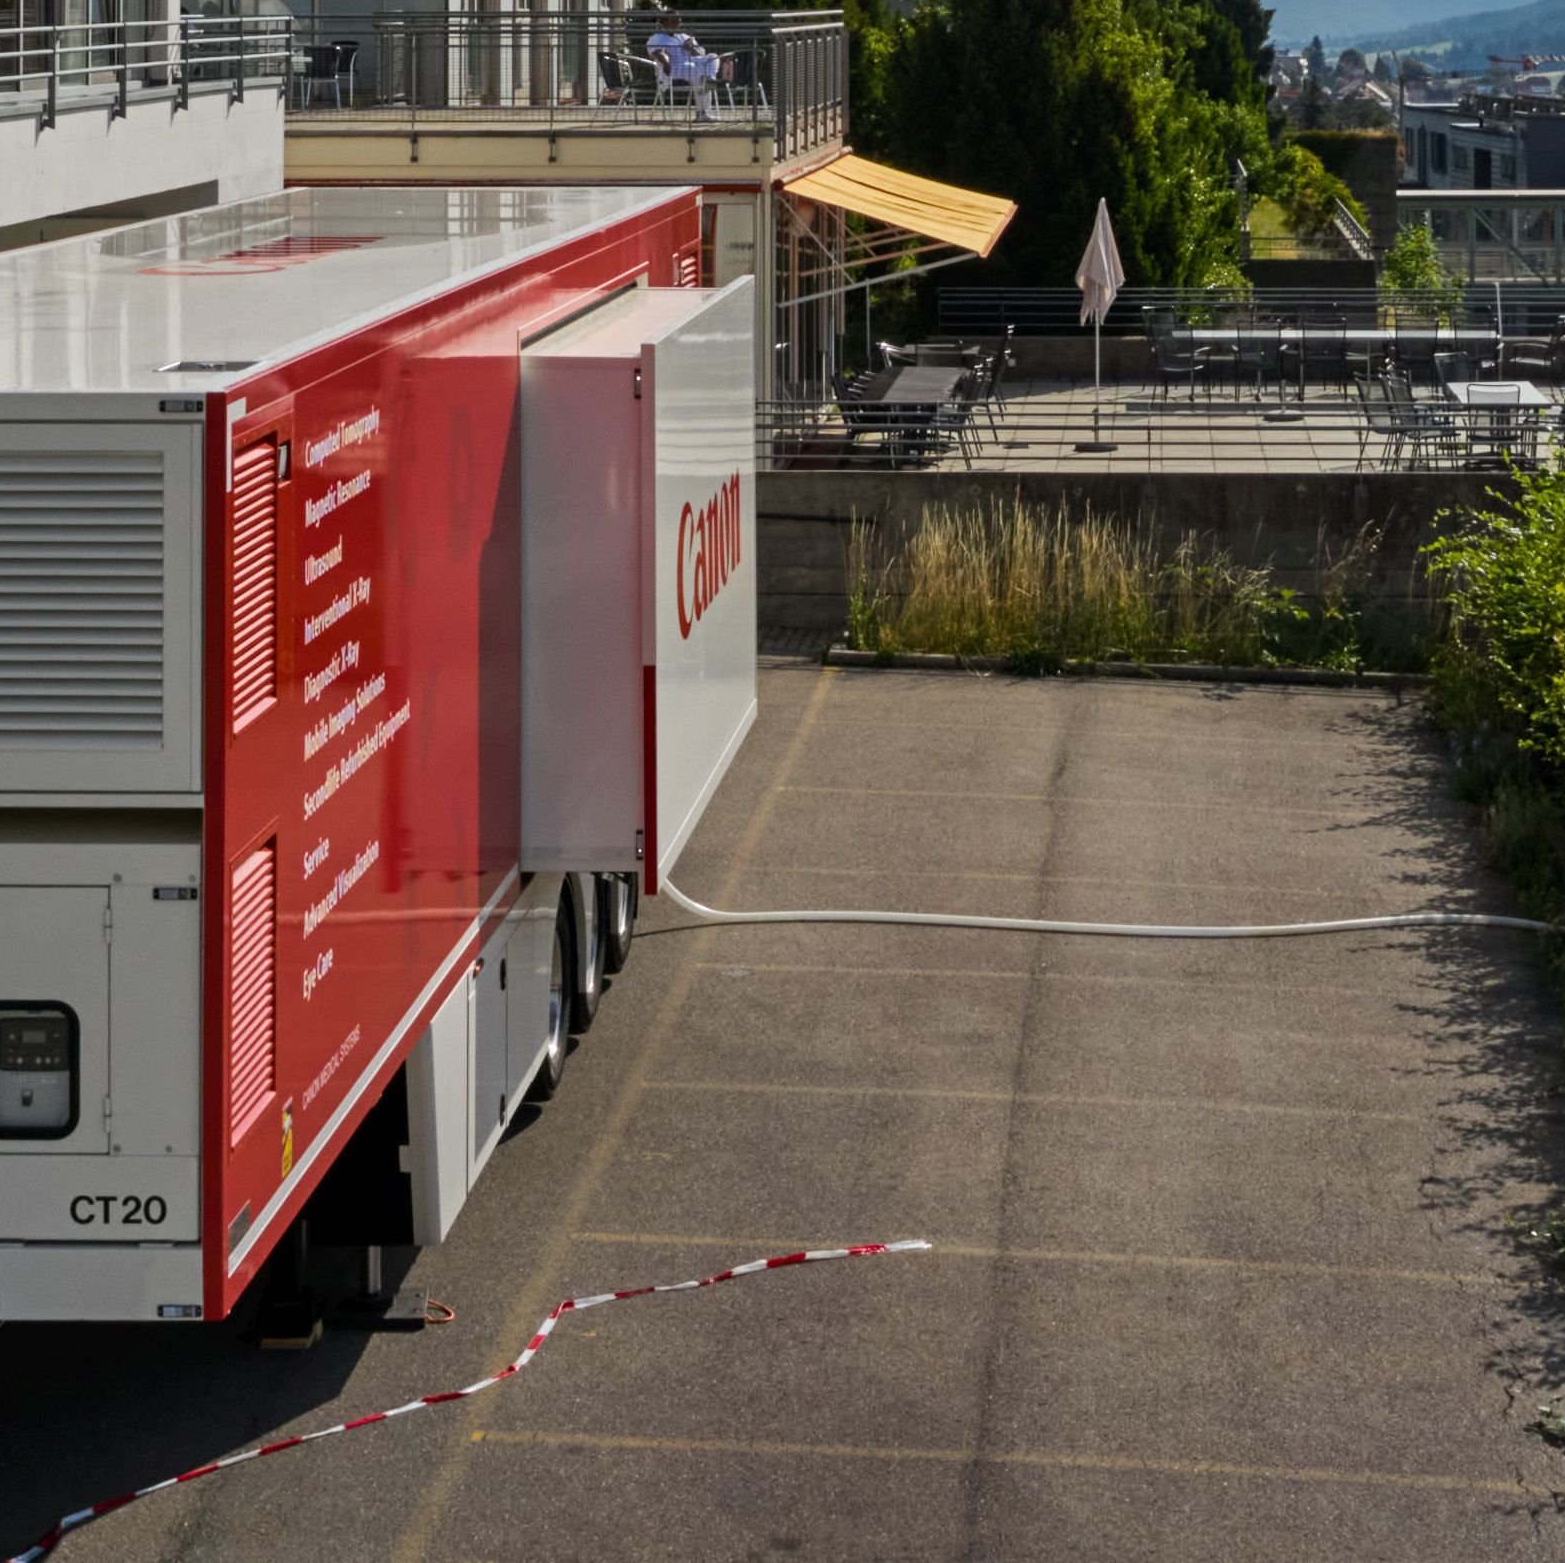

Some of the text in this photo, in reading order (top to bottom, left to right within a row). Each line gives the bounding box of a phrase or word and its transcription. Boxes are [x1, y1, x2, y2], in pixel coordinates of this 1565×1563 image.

[305, 403, 380, 468] Computed Tomography
[305, 469, 371, 528] Magnetic Resonance
[304, 534, 343, 586] Ultrasound
[676, 466, 741, 640] Canon
[304, 576, 371, 646] Interventional X-Ray
[304, 640, 360, 704] Diagnostic X-Ray
[304, 672, 386, 762] Mobile Imaging Solutions
[304, 696, 410, 821] Secondlife Refurbished Equipment
[303, 836, 330, 880] Service
[303, 840, 380, 940] Advanced Visualization
[303, 948, 333, 1002] Eye Care
